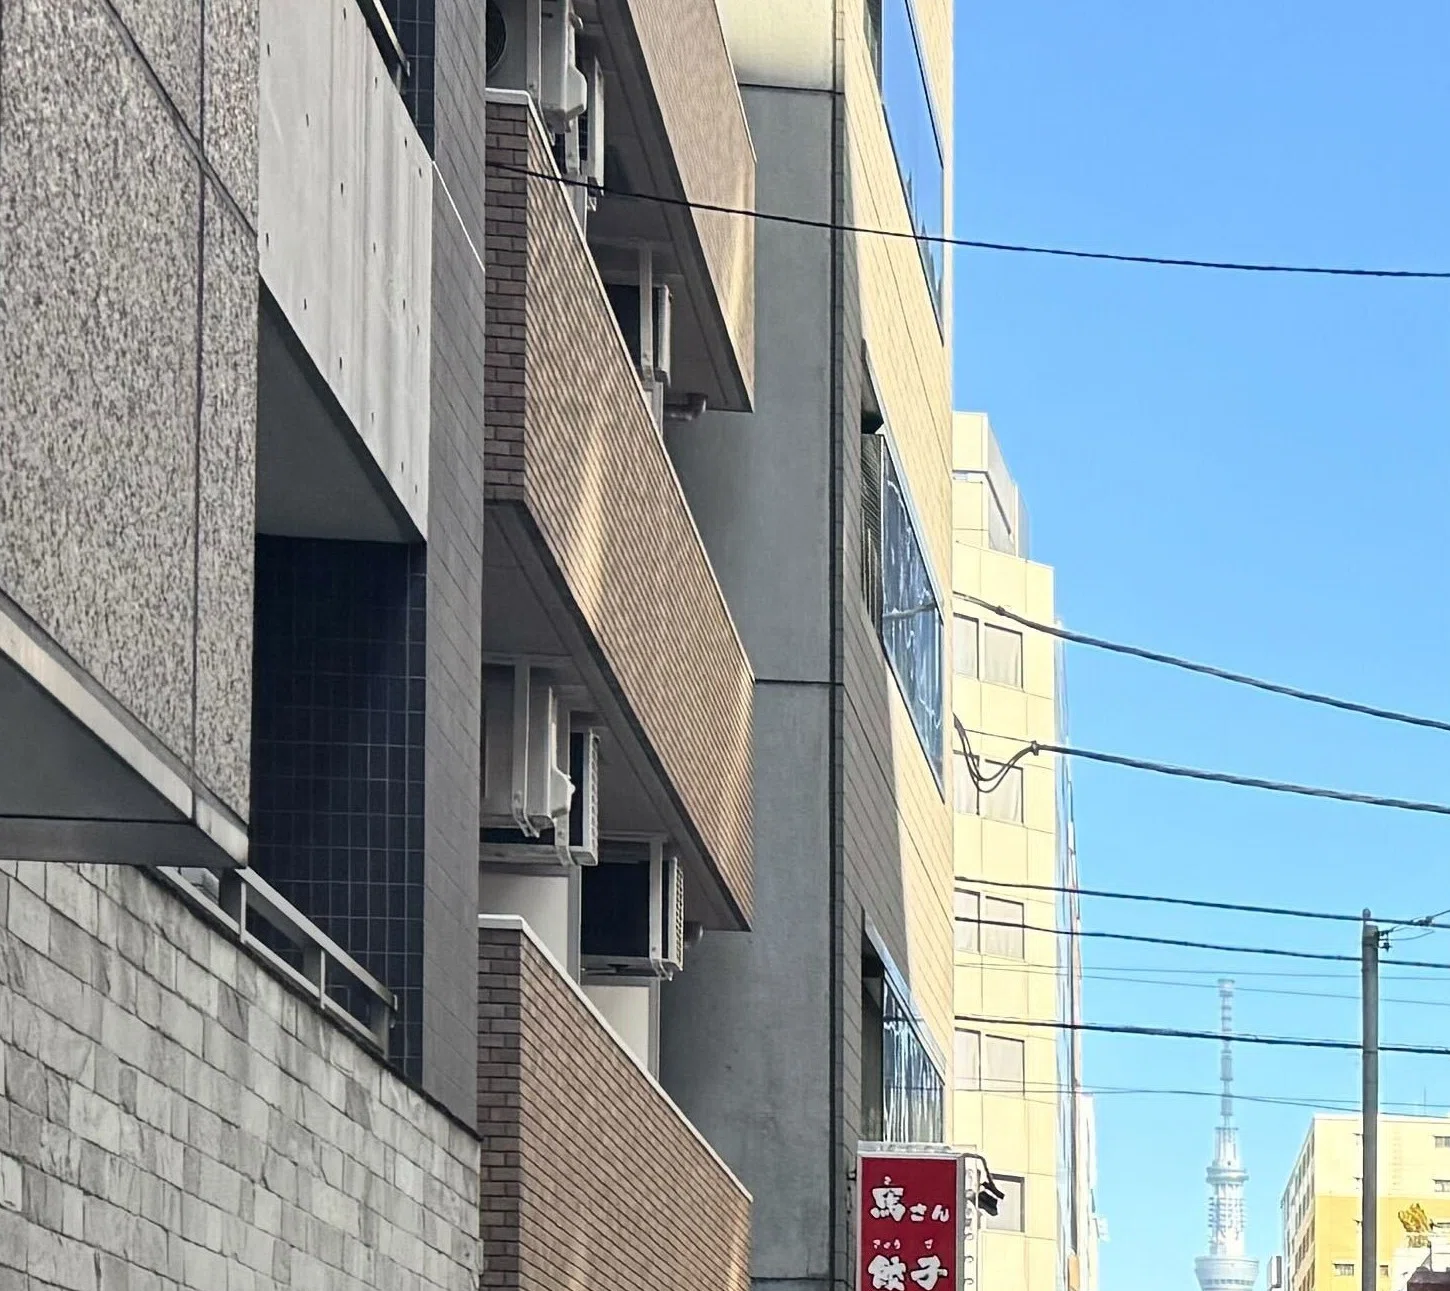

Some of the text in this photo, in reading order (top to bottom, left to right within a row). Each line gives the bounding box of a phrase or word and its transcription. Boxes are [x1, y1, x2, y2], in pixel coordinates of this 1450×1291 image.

[869, 1186, 950, 1222] 馬さん
[867, 1254, 948, 1291] 餃子
